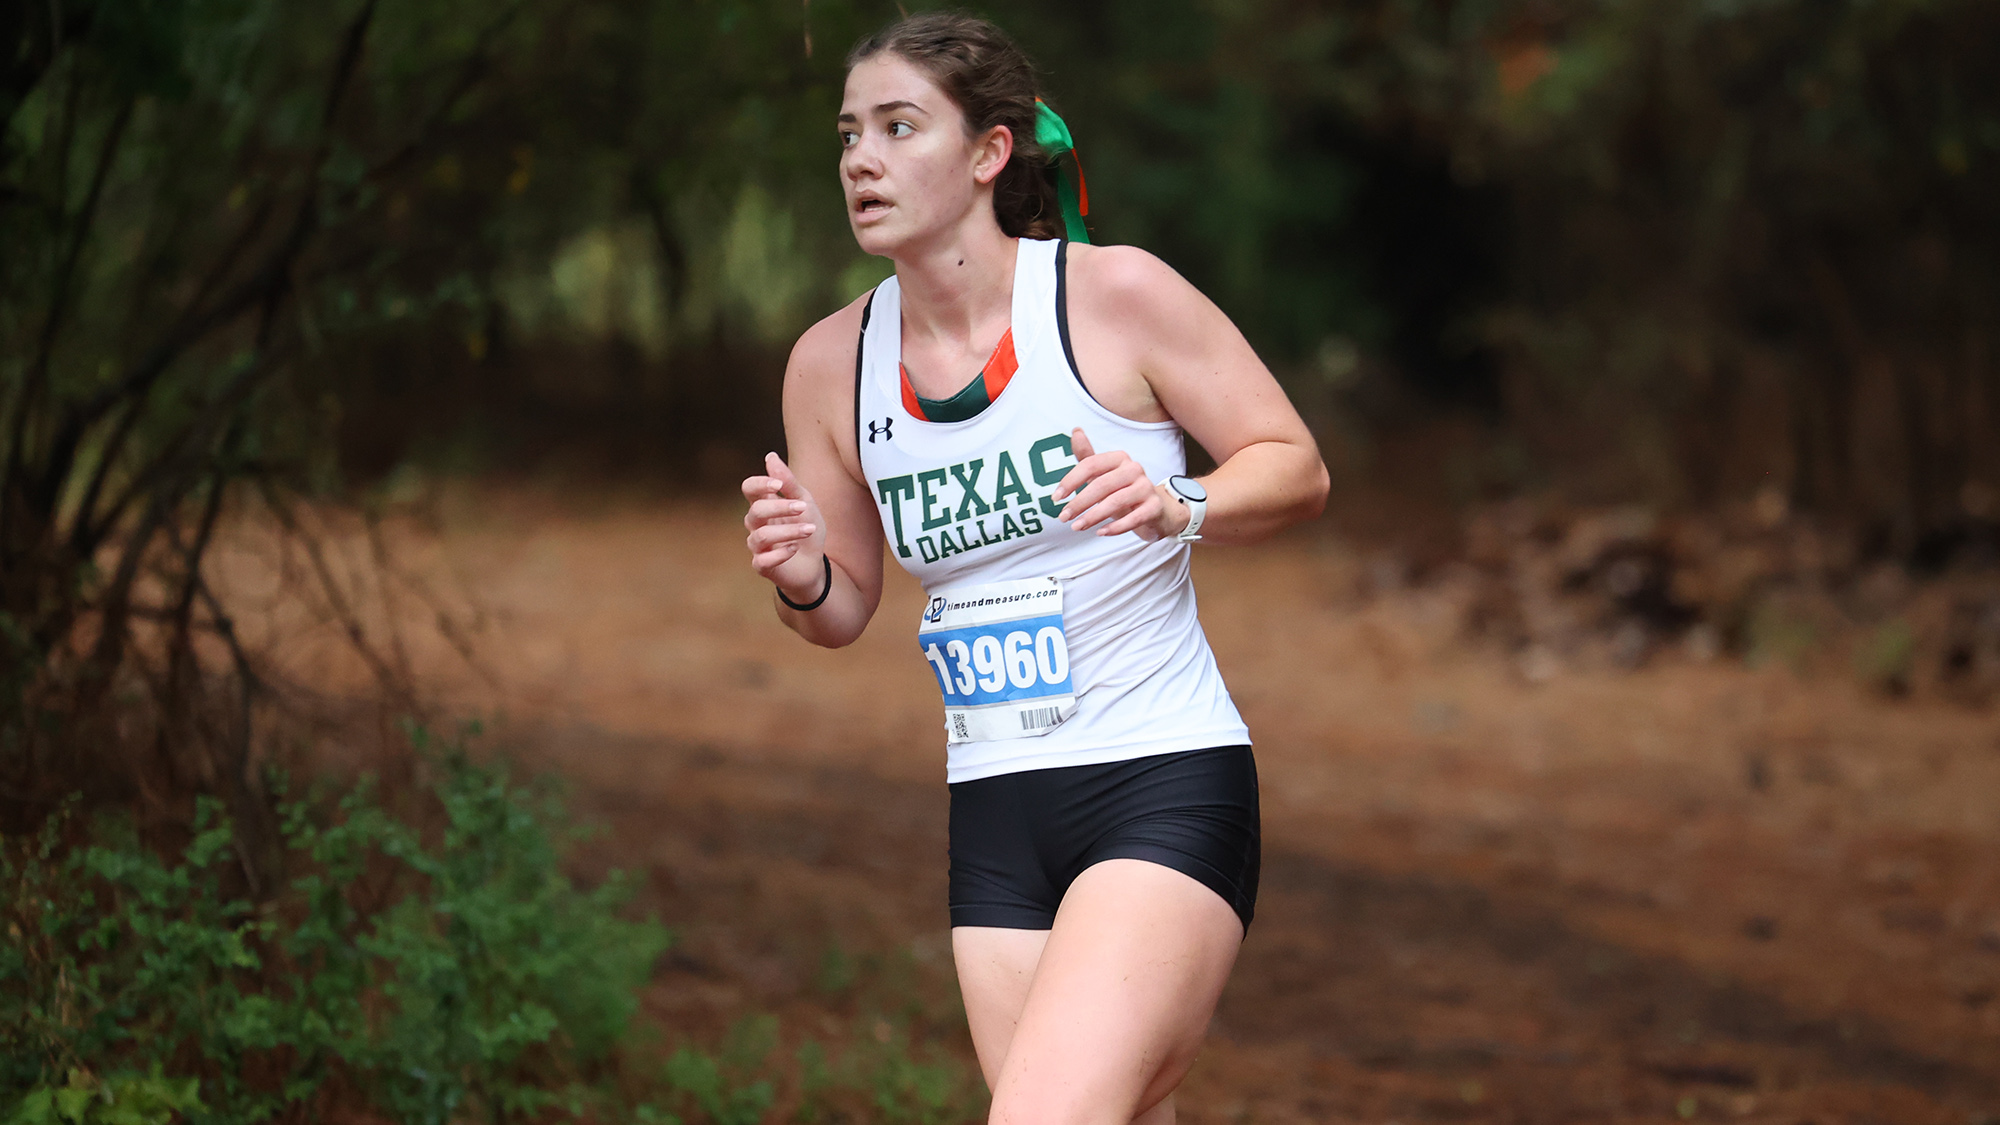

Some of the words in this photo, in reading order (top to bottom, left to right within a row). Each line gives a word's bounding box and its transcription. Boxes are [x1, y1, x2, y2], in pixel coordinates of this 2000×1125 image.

[877, 433, 1088, 558] TEXAS
[916, 507, 1043, 564] DALLAS
[947, 588, 1058, 611] timeandmeasure.com
[924, 626, 1069, 696] 13960
